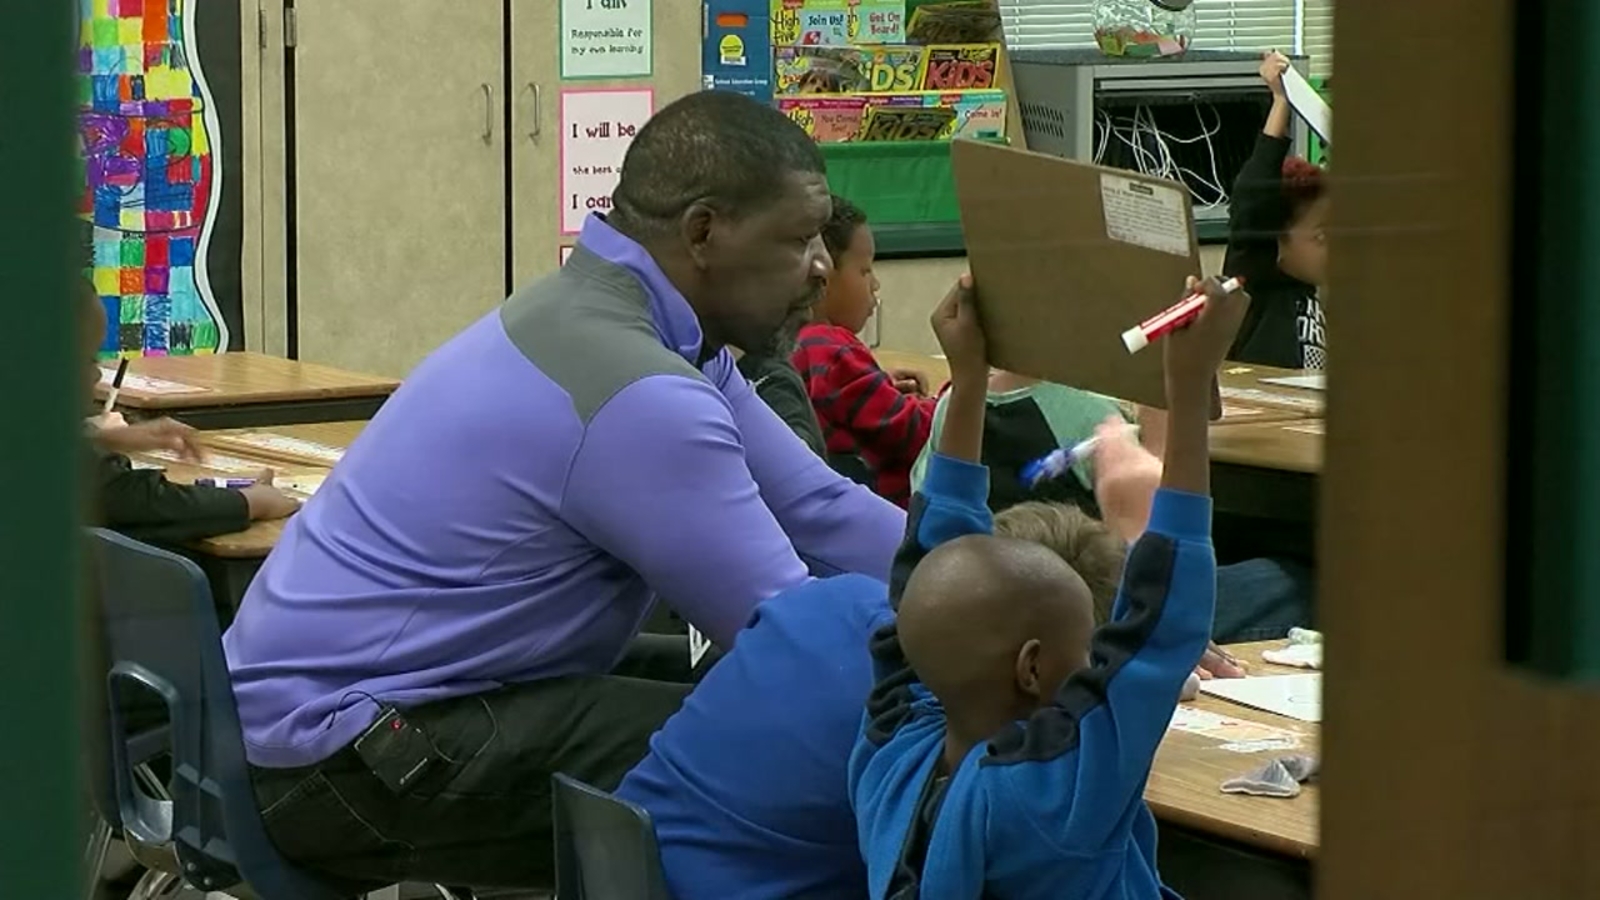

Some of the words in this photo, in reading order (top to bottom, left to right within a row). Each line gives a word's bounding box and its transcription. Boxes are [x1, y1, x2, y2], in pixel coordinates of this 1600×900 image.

[771, 9, 800, 31] High
[808, 14, 827, 26] Join
[829, 14, 844, 26] Us!
[869, 12, 885, 23] Get
[571, 28, 624, 40] Responsible
[627, 28, 642, 37] for
[571, 46, 586, 56] my
[573, 123, 578, 138] I
[586, 122, 610, 138] will
[617, 122, 636, 138] be
[573, 165, 589, 175] the
[593, 165, 612, 175] best
[573, 193, 578, 210] I
